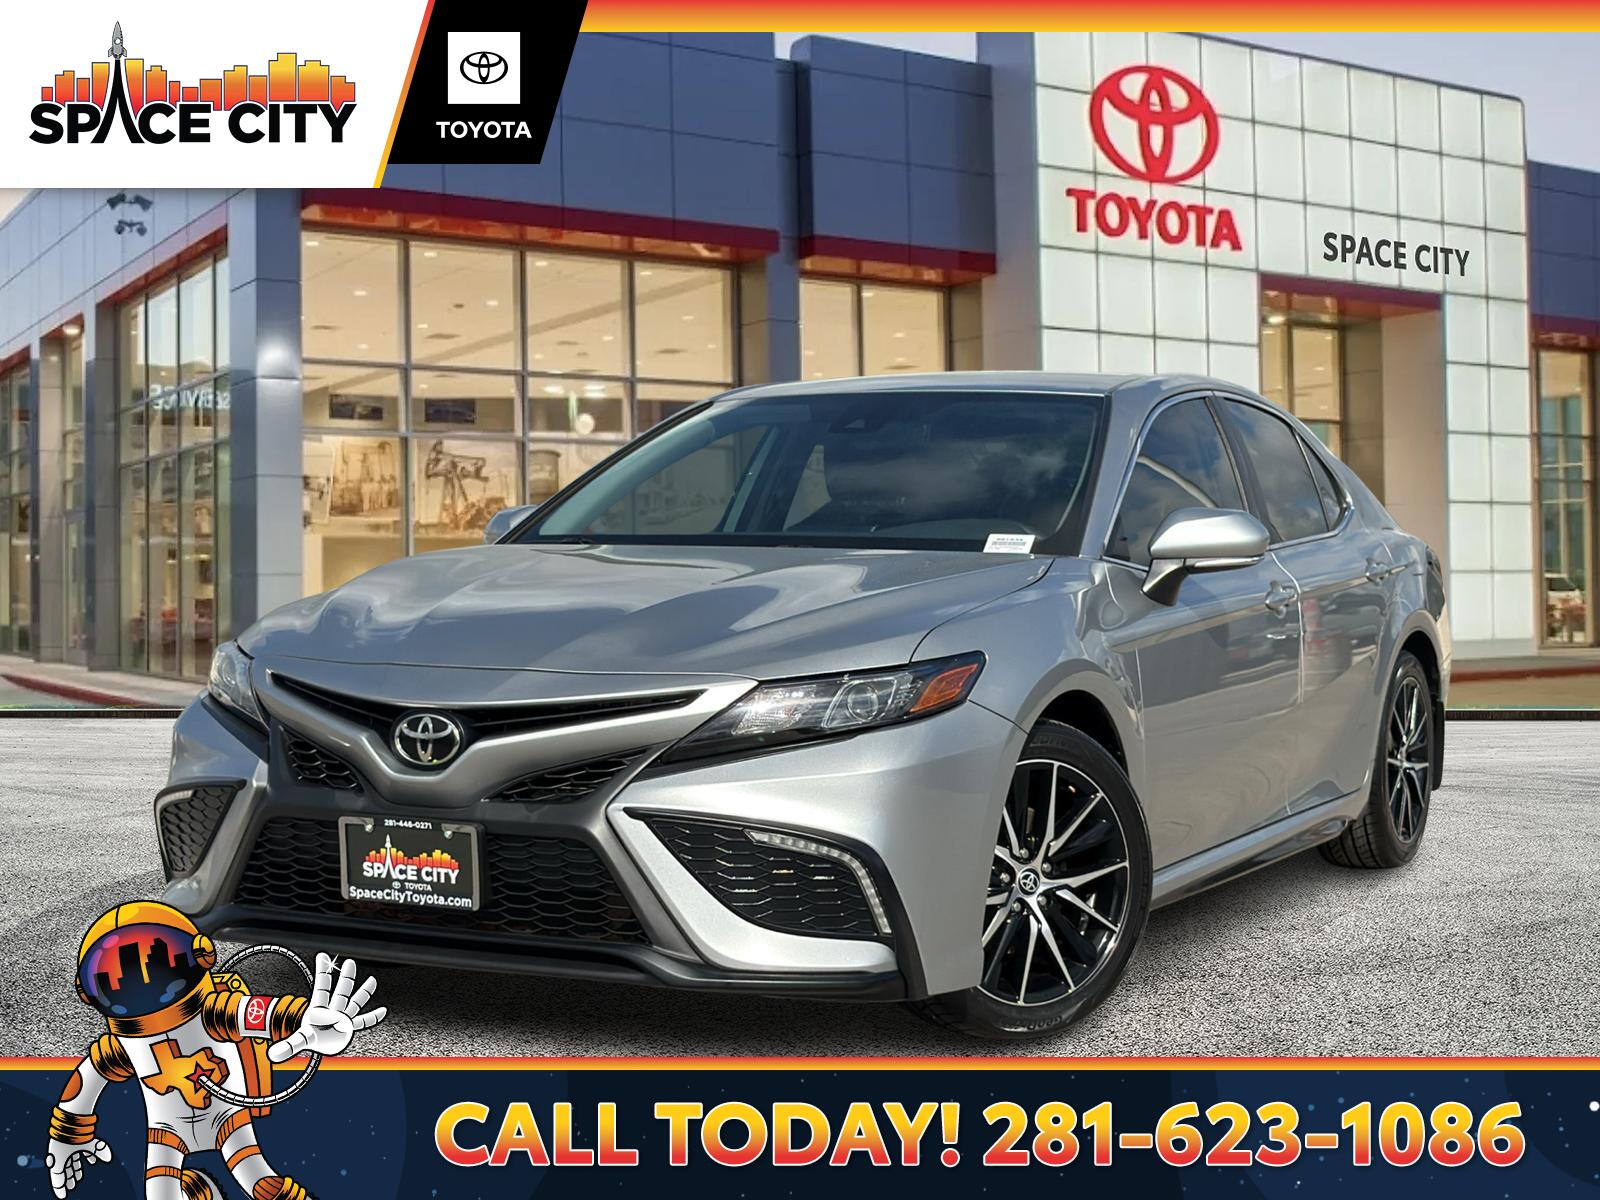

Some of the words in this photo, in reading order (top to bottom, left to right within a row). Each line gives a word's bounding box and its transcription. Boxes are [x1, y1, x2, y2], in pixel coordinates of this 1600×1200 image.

[1066, 187, 1242, 251] TOYOTA
[1323, 232, 1407, 270] SPACE
[1414, 244, 1470, 277] CITY
[362, 856, 418, 880] SPACE
[421, 866, 460, 884] CITY
[349, 886, 472, 908] SpaceCityToyota.com
[404, 882, 432, 892] TOYOTA
